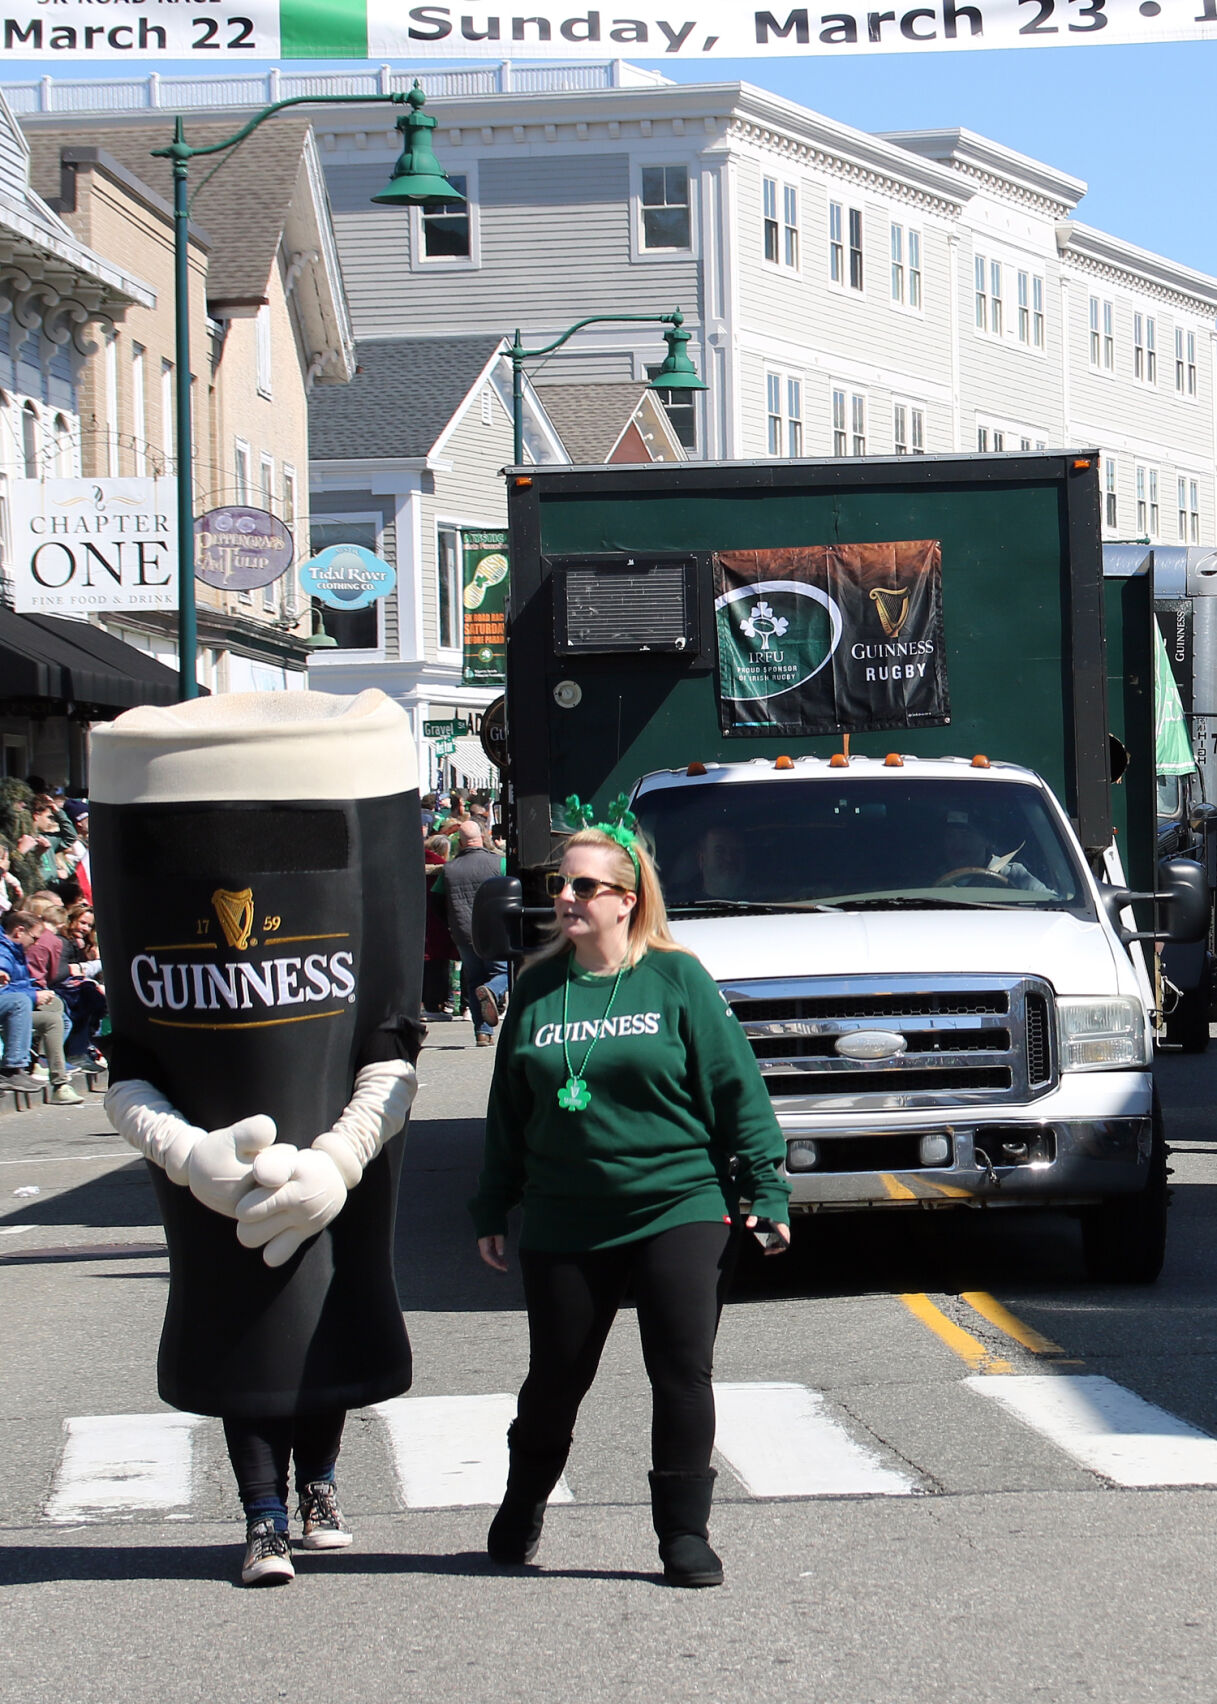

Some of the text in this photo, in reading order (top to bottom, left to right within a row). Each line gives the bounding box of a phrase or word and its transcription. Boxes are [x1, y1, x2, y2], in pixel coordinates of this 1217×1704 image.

[4, 17, 256, 49] March 22
[408, 6, 720, 53] Sunday,
[754, 0, 984, 44] March
[1019, 0, 1109, 35] 23
[30, 514, 170, 535] CHAPTER
[30, 541, 172, 588] ONE
[309, 566, 387, 583] Tidal River
[317, 582, 359, 590] CLOTHING
[31, 594, 173, 606] FINE FOOD & DRINK
[464, 623, 505, 635] SATURDA
[1174, 608, 1186, 662] GUINNESS
[749, 650, 784, 664] IRFU
[851, 639, 934, 660] GUINNESS
[736, 665, 798, 674] PROUD SPONSOR
[771, 673, 796, 681] RUGBY
[866, 662, 926, 682] RUGBY
[424, 722, 454, 736] Gravel
[197, 915, 281, 934] 17 59
[131, 951, 356, 1010] GUINNESS
[535, 1012, 661, 1048] GUINNESS
